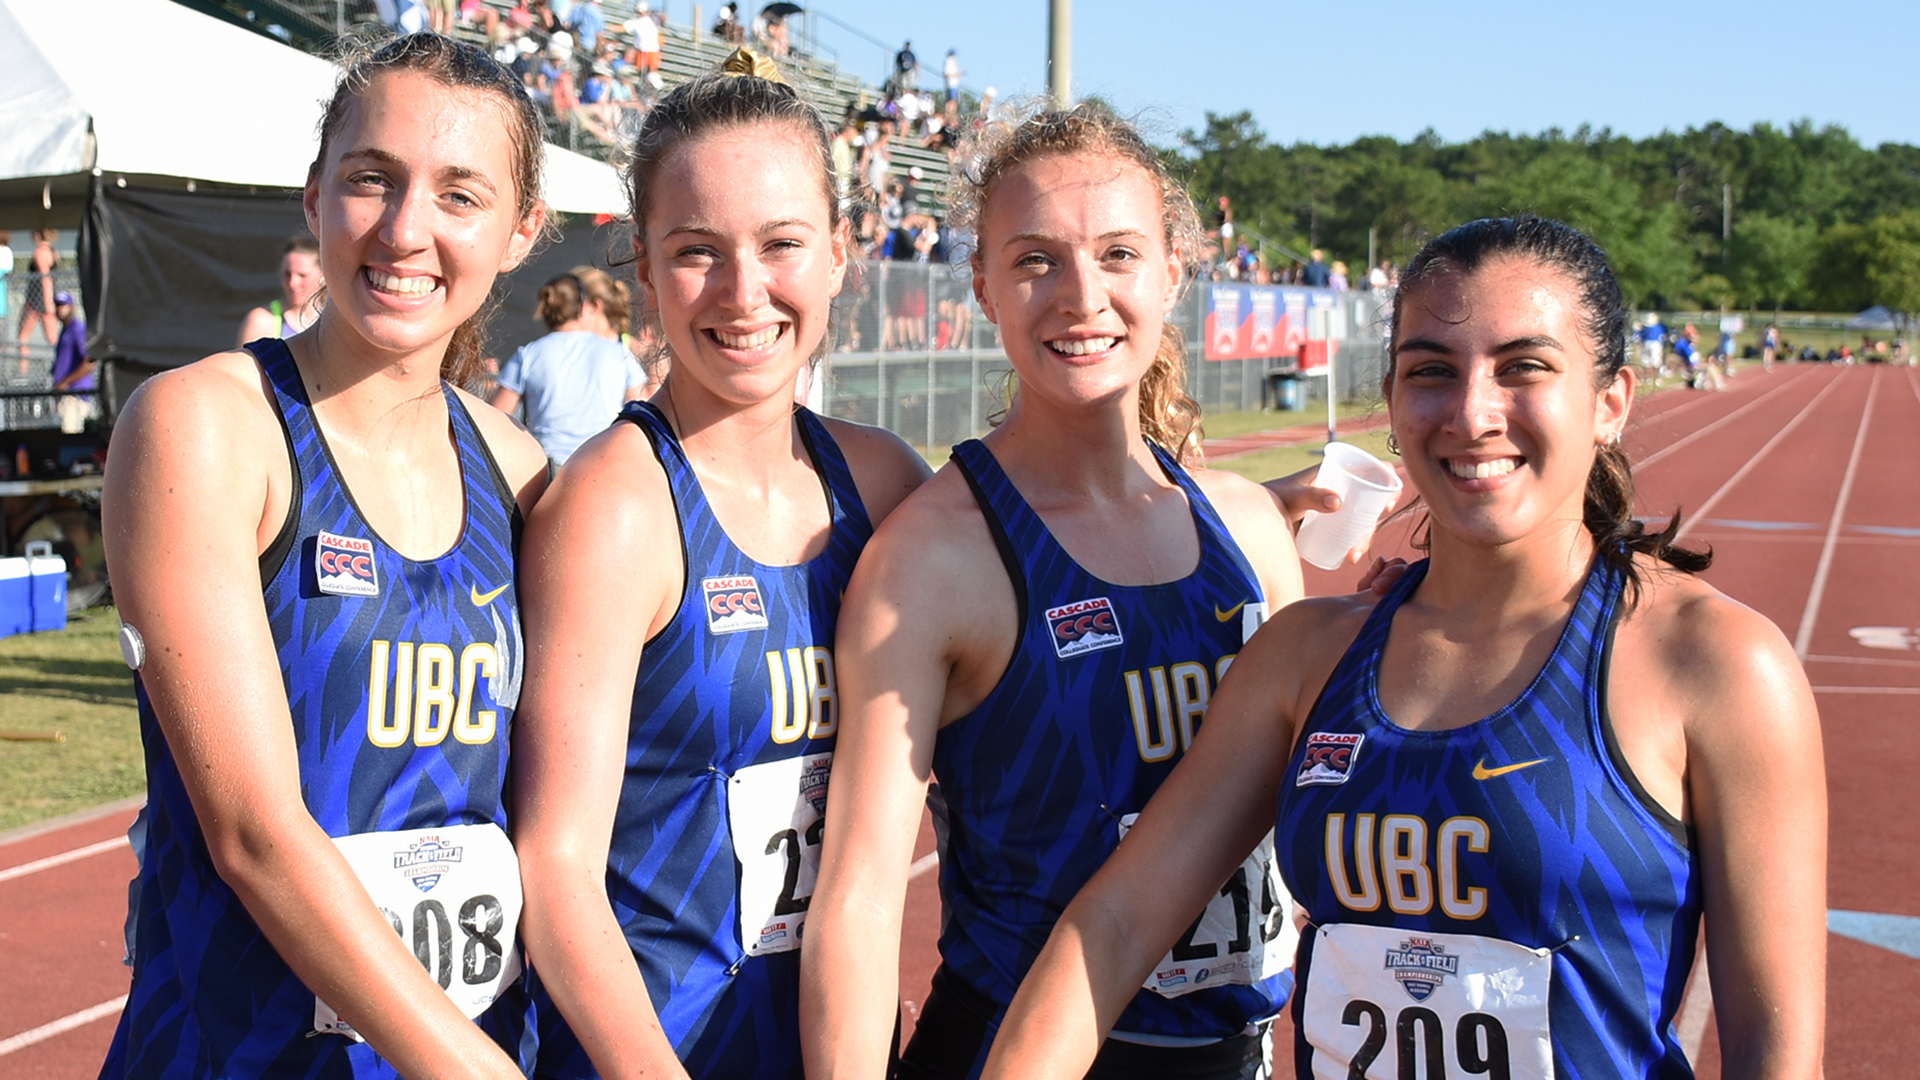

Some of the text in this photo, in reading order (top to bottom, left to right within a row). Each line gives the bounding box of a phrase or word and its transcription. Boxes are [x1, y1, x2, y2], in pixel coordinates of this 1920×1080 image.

[321, 534, 370, 551] CASCADE
[321, 551, 373, 578] CCC
[705, 579, 755, 590] CASCADE
[711, 592, 761, 615] CCC
[1047, 599, 1109, 619] CASCADE
[1055, 612, 1116, 640] CCC
[367, 639, 498, 748] UBC
[766, 646, 839, 744] UB
[1325, 813, 1490, 920] UBC
[1386, 951, 1421, 967] TRACK
[1425, 955, 1457, 974] FIELD
[1341, 1000, 1511, 1080] 209
